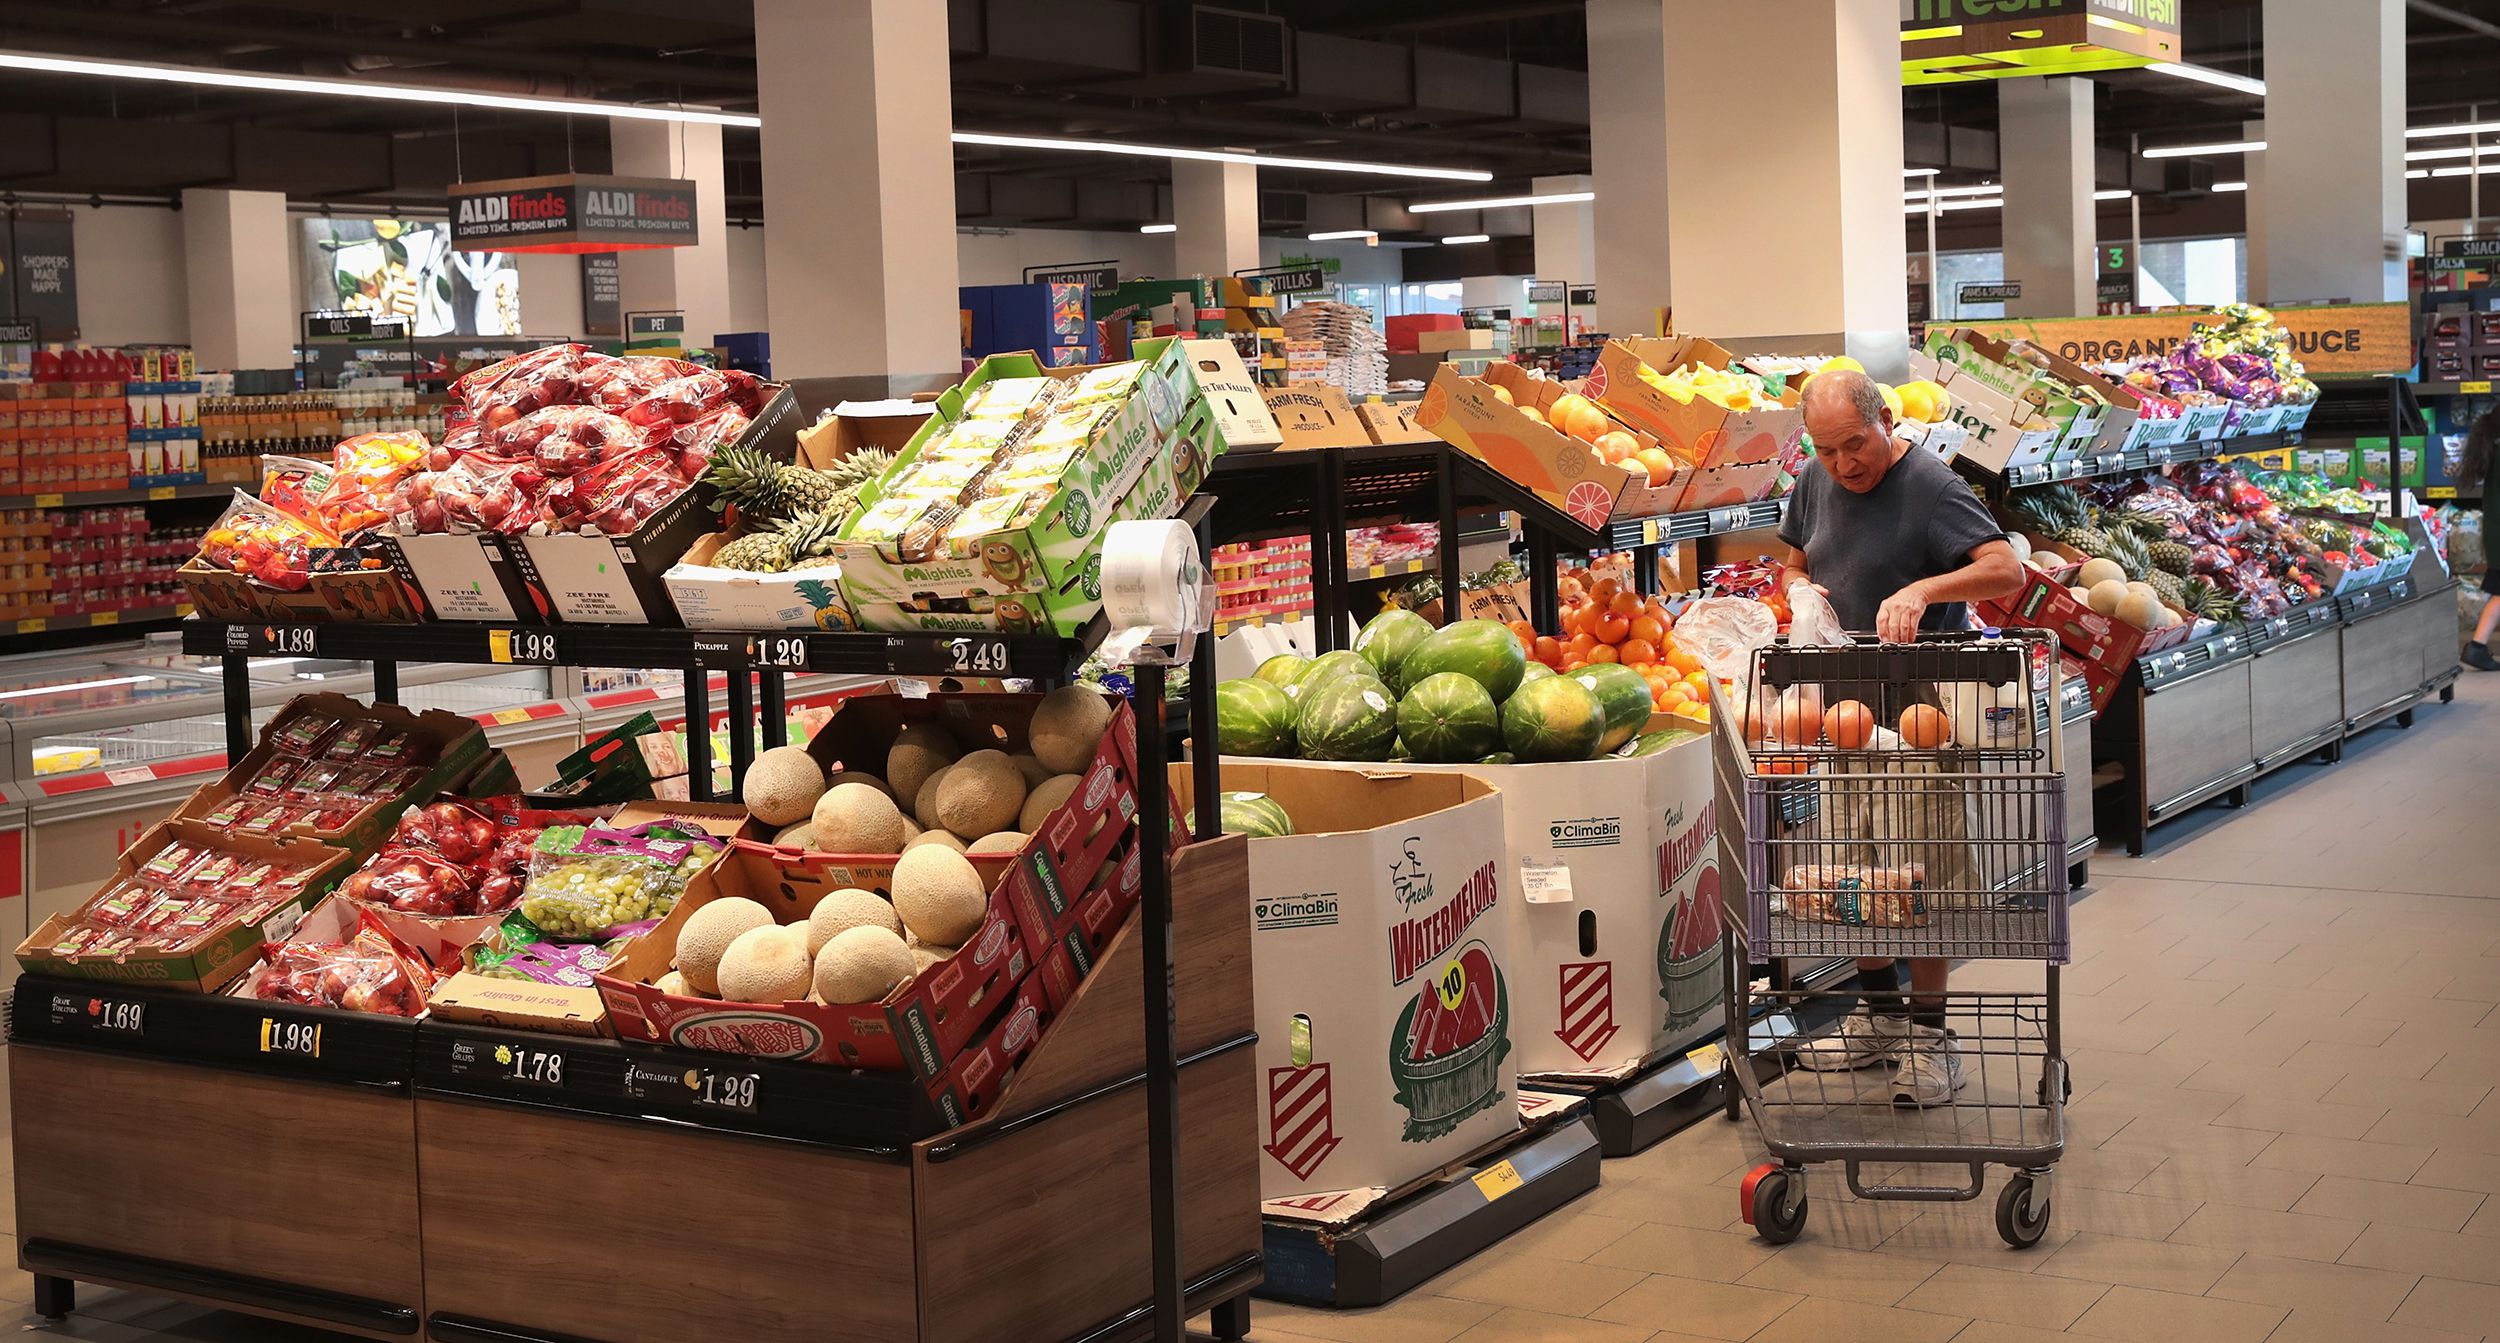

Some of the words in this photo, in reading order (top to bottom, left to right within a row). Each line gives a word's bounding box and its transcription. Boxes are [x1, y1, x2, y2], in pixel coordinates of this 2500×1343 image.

[458, 193, 568, 225] ALDIfinds
[586, 190, 690, 220] ALDIfinds
[459, 225, 489, 236] LIMITED
[511, 220, 546, 232] PREMIUM
[547, 218, 568, 229] BUYS
[22, 255, 69, 270] SHOPPERS
[2108, 247, 2124, 269] 3
[2434, 258, 2465, 269] SALSA
[33, 268, 60, 281] MADE
[1907, 260, 1920, 279] 4
[1963, 286, 1982, 298] JAMS
[1989, 286, 2020, 298] SPREADS
[330, 320, 350, 334] OILS
[651, 318, 665, 331] PET
[2060, 336, 2180, 363] ORGANI
[1961, 359, 2016, 395] Mighties
[1209, 382, 1226, 392] THE
[1225, 382, 1253, 394] VALLEY
[1265, 394, 1294, 411] FARM
[1293, 393, 1325, 409] FRESH
[1455, 394, 1496, 421] PARAMOUNT
[1638, 392, 1670, 414] PARAMOUNT
[1464, 407, 1481, 420] CITRUS
[2184, 409, 2225, 437] Rainier
[2232, 412, 2272, 436] Rainier
[2134, 420, 2179, 443] Rainier
[1090, 421, 1147, 500] Mighties
[1106, 472, 1127, 498] AMAZING
[642, 522, 667, 545] PREMIUM
[666, 508, 682, 526] READY
[690, 493, 699, 505] EAT
[1075, 506, 1090, 533] KIWI
[903, 566, 974, 583] Mighties
[1469, 596, 1490, 615] FARM
[1490, 594, 1518, 608] FRESH
[920, 614, 987, 631] Mighties
[226, 631, 250, 639] COLORED
[226, 638, 249, 646] PEPPERS
[277, 628, 315, 653] 1.89
[887, 637, 904, 647] KIWI
[512, 634, 556, 661] 1.98
[694, 641, 729, 651] PINEAPPLE
[757, 638, 805, 666] 1.29
[952, 642, 1007, 671] 2.49
[1663, 800, 1685, 835] Fresh
[1563, 823, 1620, 837] ClimaBin
[855, 867, 872, 879] HOT
[1033, 851, 1064, 914] Cantaloupes
[1395, 873, 1435, 914] Fresh
[1270, 899, 1338, 918] ClimaBin
[1389, 859, 1498, 987] WATERMELONS
[80, 962, 170, 979] TOMATOES
[1442, 966, 1462, 1000] 10
[52, 995, 70, 1005] GRAPE
[52, 1003, 78, 1014] TOMATOES
[525, 994, 538, 1004] in
[101, 1001, 142, 1031] 1.69
[271, 1022, 314, 1054] 1.98
[453, 1042, 475, 1054] GREEN
[907, 1008, 938, 1075] Cantaloupes
[452, 1051, 475, 1063] GRAPES
[513, 1049, 562, 1085] 1.78
[635, 1069, 679, 1084] CANTALOUPE
[702, 1074, 755, 1108] 1.29
